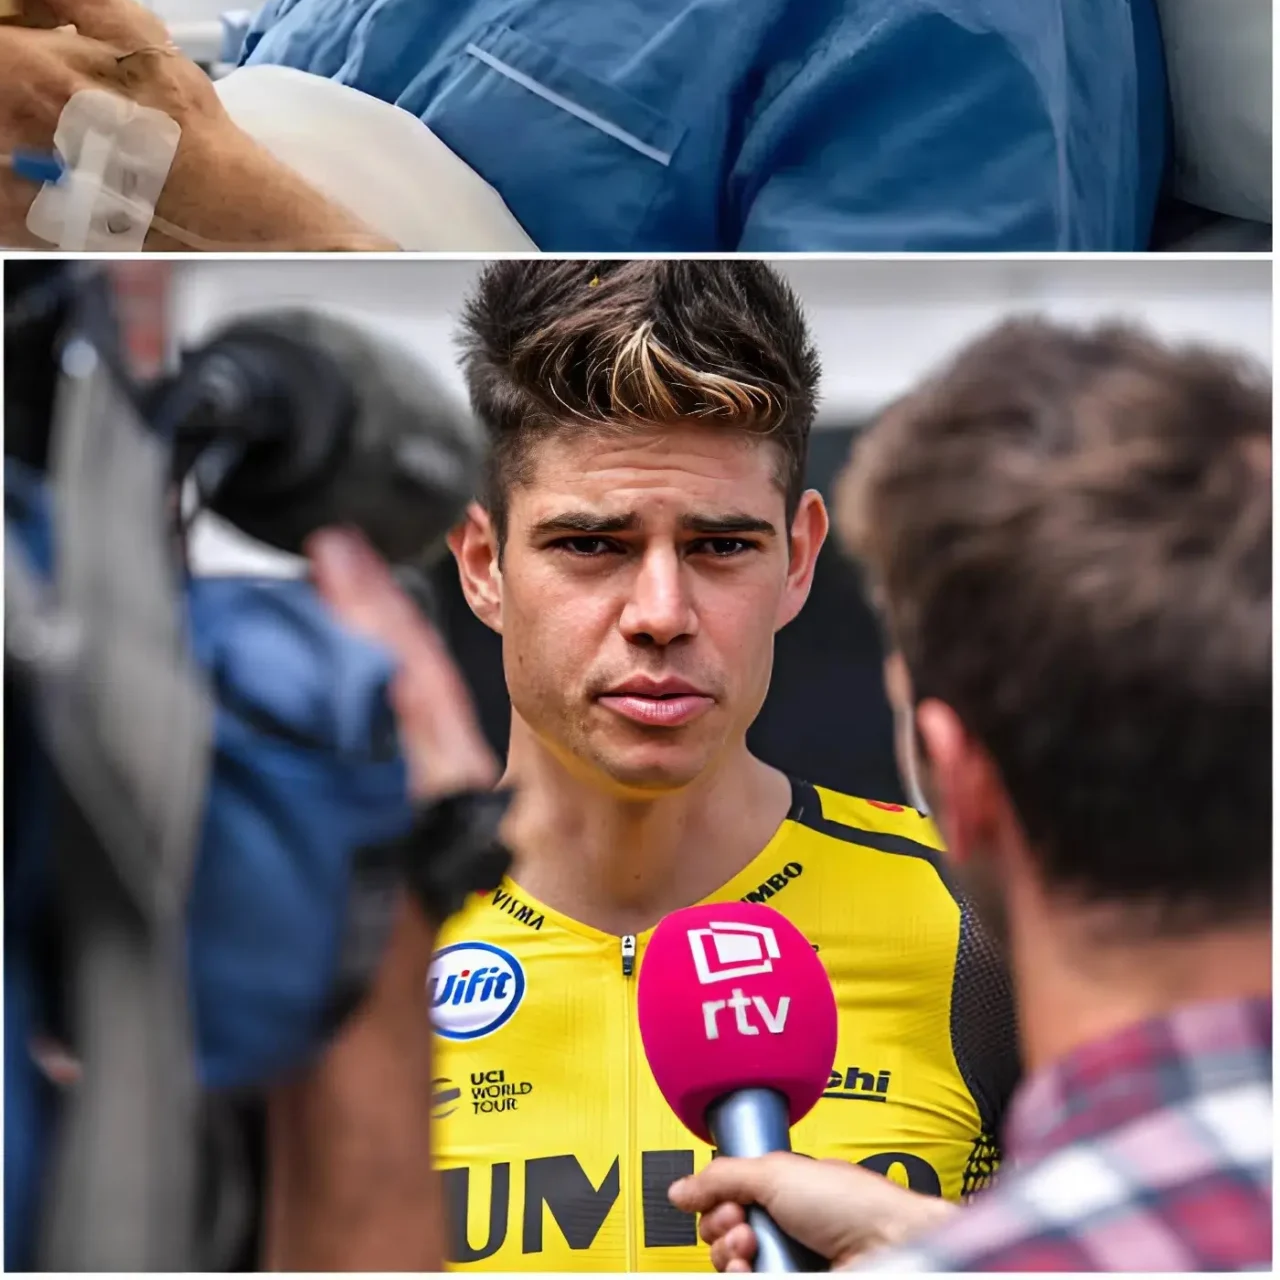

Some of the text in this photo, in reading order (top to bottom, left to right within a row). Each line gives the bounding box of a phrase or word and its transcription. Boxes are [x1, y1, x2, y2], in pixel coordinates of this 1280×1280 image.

[492, 888, 546, 931] VISMA
[702, 987, 791, 1041] rtv
[471, 1070, 505, 1086] UCI
[471, 1082, 533, 1100] WORLD
[472, 1098, 519, 1115] TOUR
